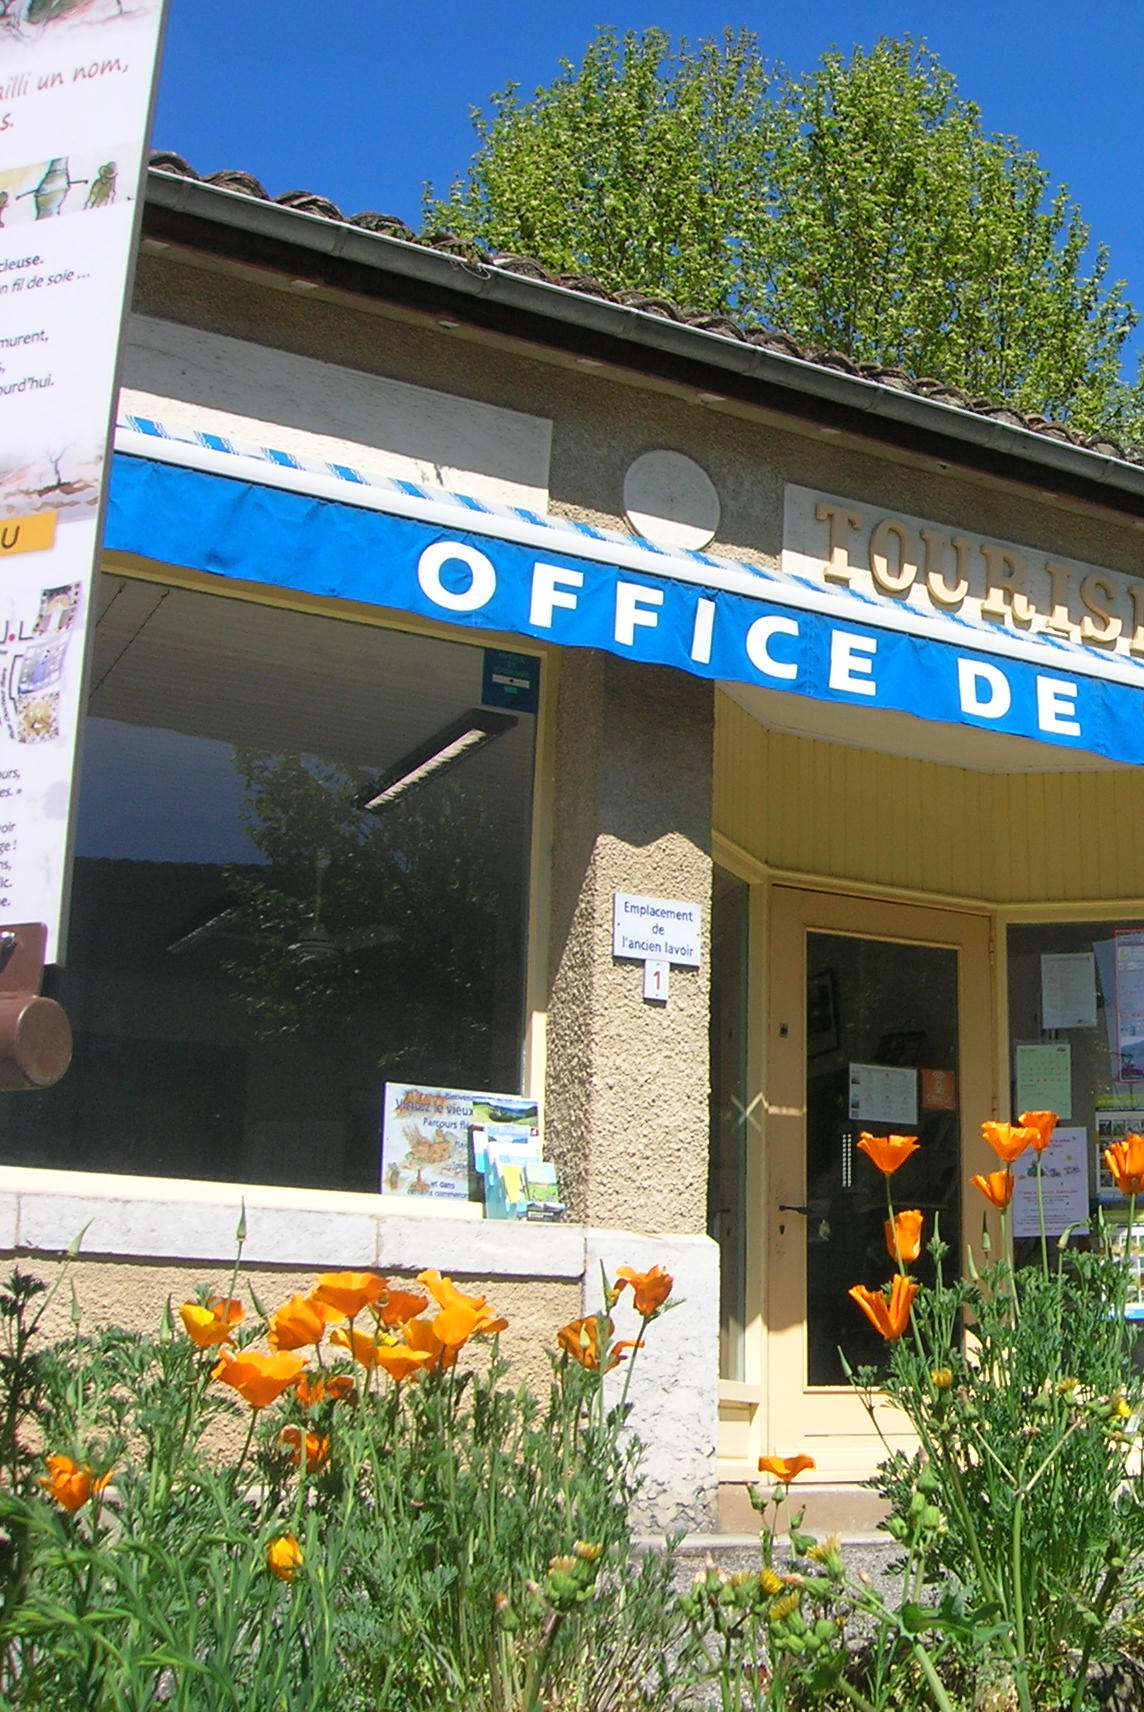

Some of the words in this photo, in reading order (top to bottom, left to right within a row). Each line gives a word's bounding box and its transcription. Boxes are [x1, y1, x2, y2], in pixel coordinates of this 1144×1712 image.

[37, 72, 64, 91] un
[73, 58, 129, 82] nom,
[26, 275, 44, 291] de
[46, 269, 75, 287] soie
[417, 540, 877, 697] OFFICE
[957, 657, 1082, 738] DE
[624, 901, 694, 922] Emplacement
[651, 923, 665, 935] de
[622, 935, 662, 953] l'ancien
[664, 942, 694, 957] lavoir
[653, 970, 661, 990] 1
